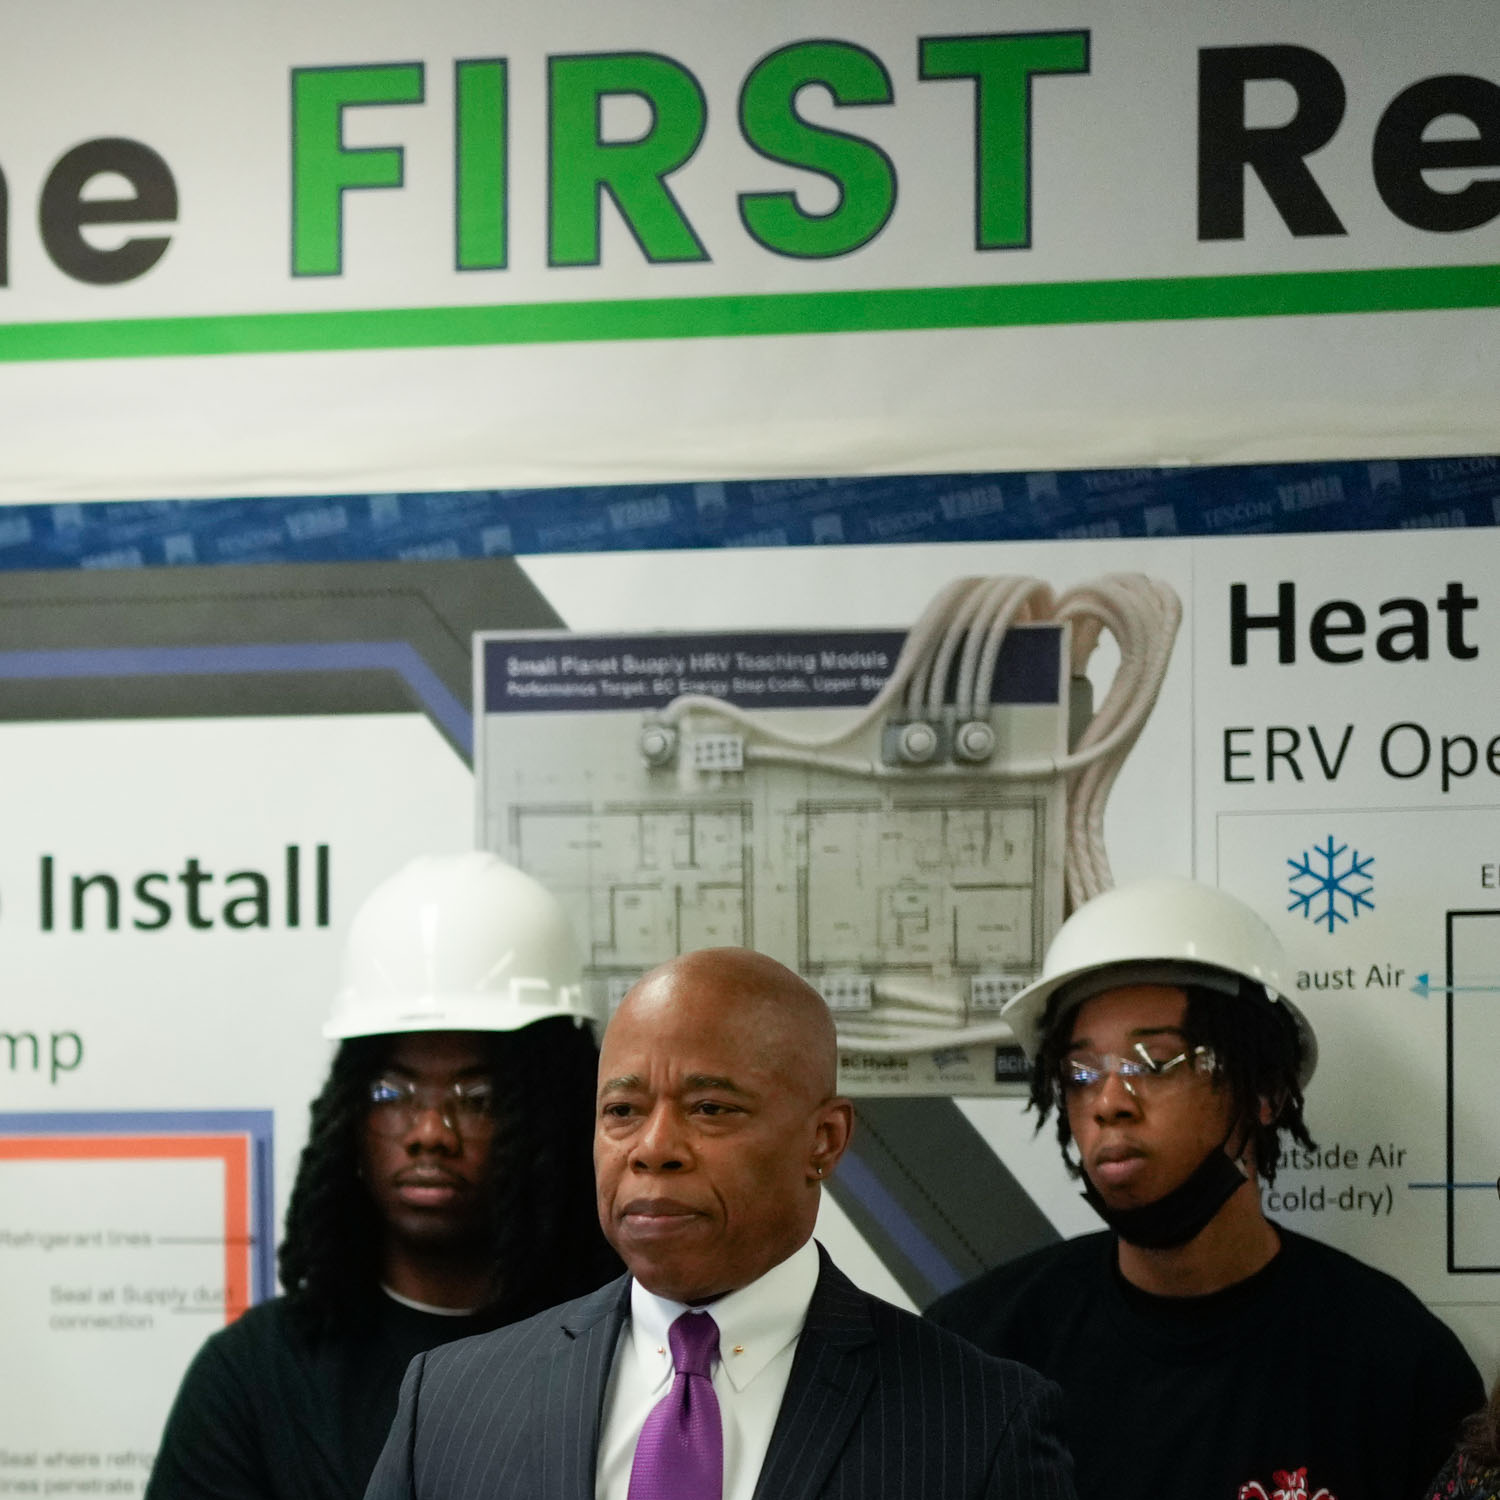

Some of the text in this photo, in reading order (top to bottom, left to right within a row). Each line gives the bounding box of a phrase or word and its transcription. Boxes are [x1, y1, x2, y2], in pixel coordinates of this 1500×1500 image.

[287, 28, 1091, 279] FIRST
[1229, 580, 1480, 666] Heat
[1223, 722, 1355, 784] ERV
[38, 844, 334, 933] Install
[1295, 963, 1405, 991] aust Air
[1368, 1142, 1408, 1168] Air
[107, 1230, 152, 1248] lines
[50, 1285, 92, 1305] Seal
[98, 1287, 115, 1304] at
[122, 1284, 186, 1308] Supply
[49, 1315, 154, 1332] connection
